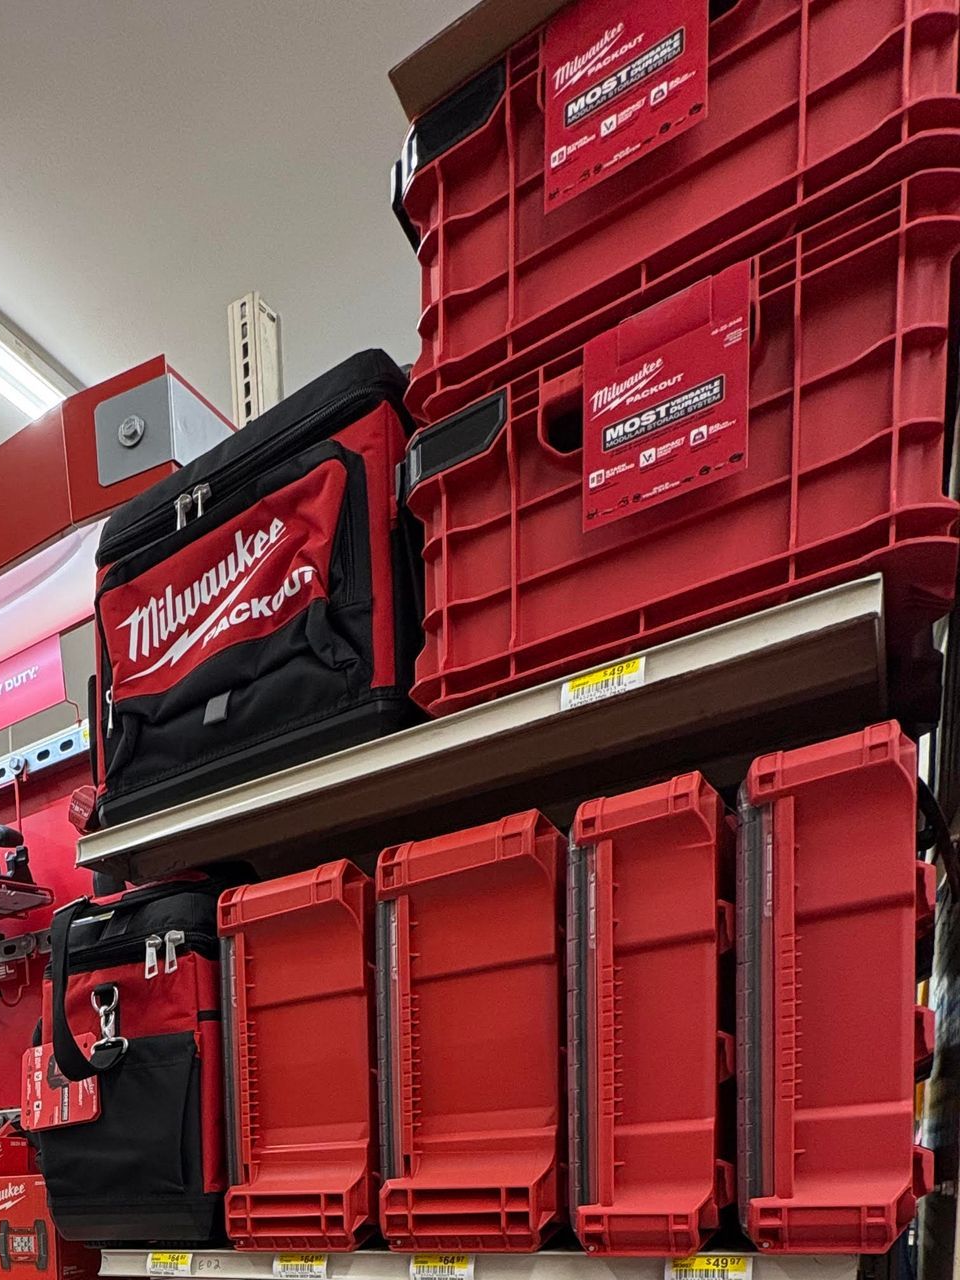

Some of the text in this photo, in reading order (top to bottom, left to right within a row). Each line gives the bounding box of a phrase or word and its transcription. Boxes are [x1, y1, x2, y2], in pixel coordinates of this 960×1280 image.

[552, 22, 624, 90] Milwaukee
[588, 33, 644, 77] PACKOUT
[630, 40, 680, 77] DURABLE
[631, 32, 681, 68] VERSATILE
[647, 47, 681, 76] SYSTEM
[567, 66, 631, 118] MOST
[590, 358, 663, 412] Milwaukee
[625, 373, 684, 405] PACKOUT
[669, 379, 720, 406] VERSATILE
[669, 387, 720, 414] DURABLE
[605, 394, 721, 448] MODULAR STORAGE SYSTEM
[606, 403, 671, 441] MOST
[115, 517, 284, 662] Milwaukee
[201, 565, 318, 650] PACKOUT
